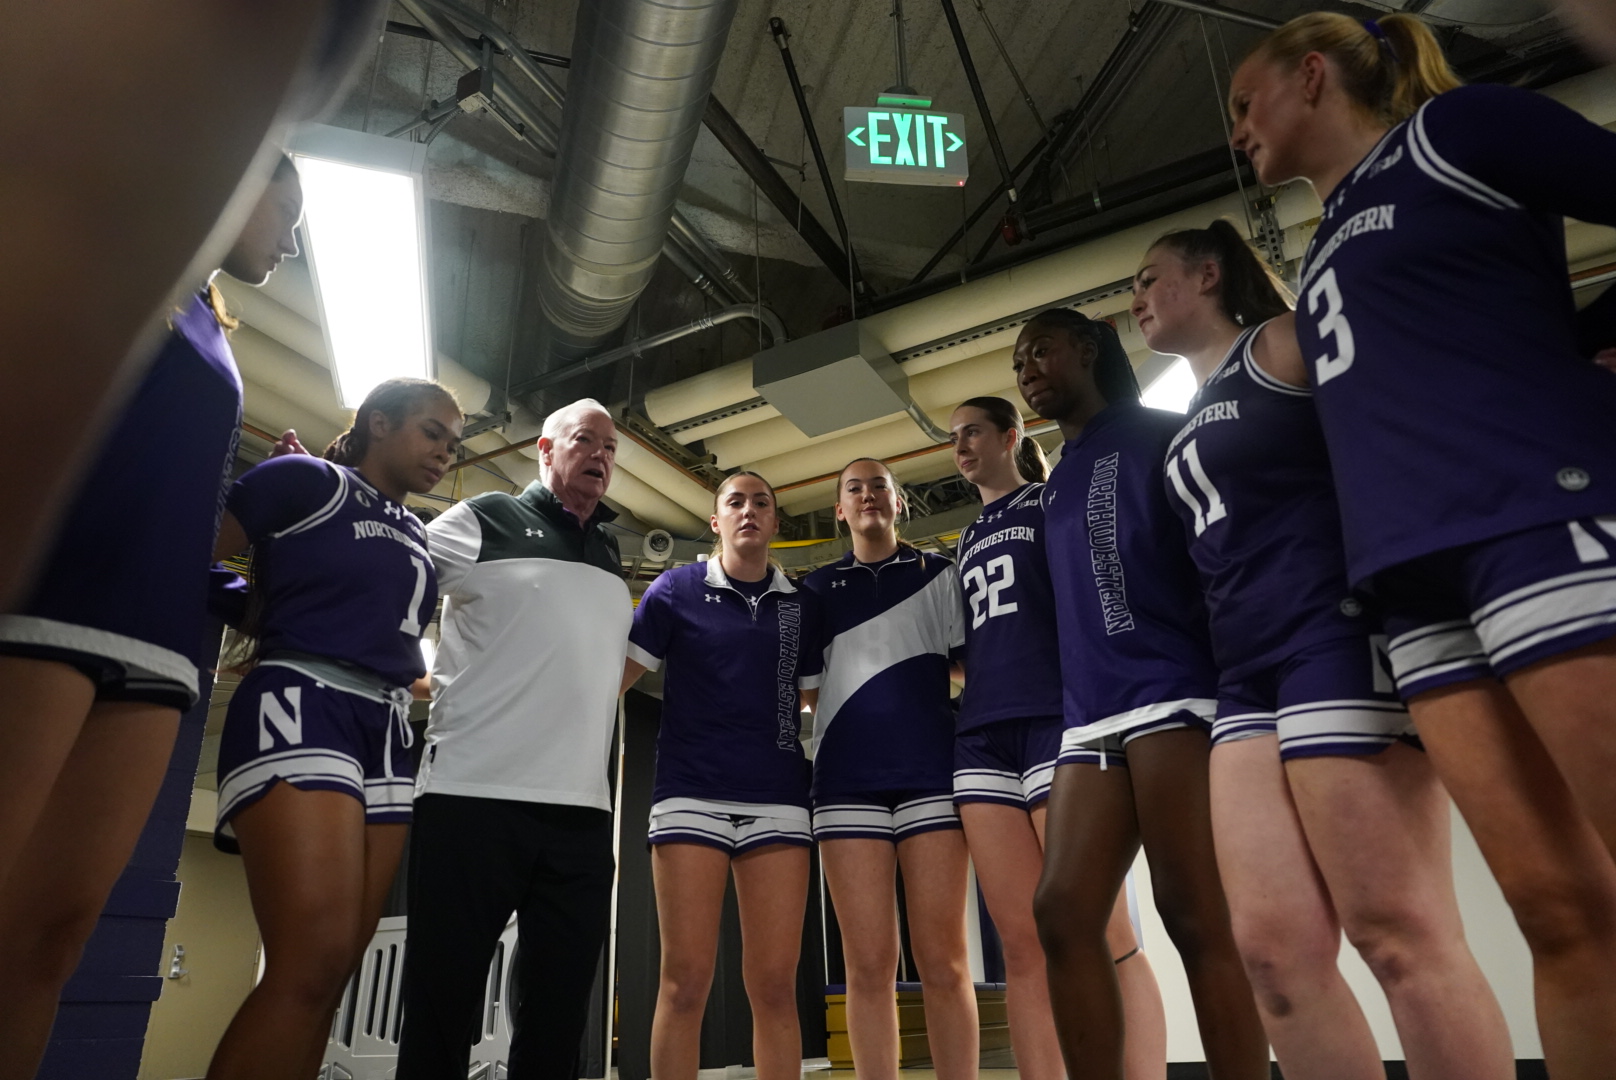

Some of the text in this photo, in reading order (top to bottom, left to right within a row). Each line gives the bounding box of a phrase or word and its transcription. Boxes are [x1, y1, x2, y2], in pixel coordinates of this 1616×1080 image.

[866, 111, 948, 168] EXIT
[1307, 266, 1356, 387] 3
[1166, 438, 1228, 538] 11
[1087, 451, 1135, 636] NORTHWESTERN
[398, 554, 428, 637] 1
[962, 554, 1019, 631] 22
[258, 685, 303, 753] N
[776, 600, 801, 753] NORTHWESTERN
